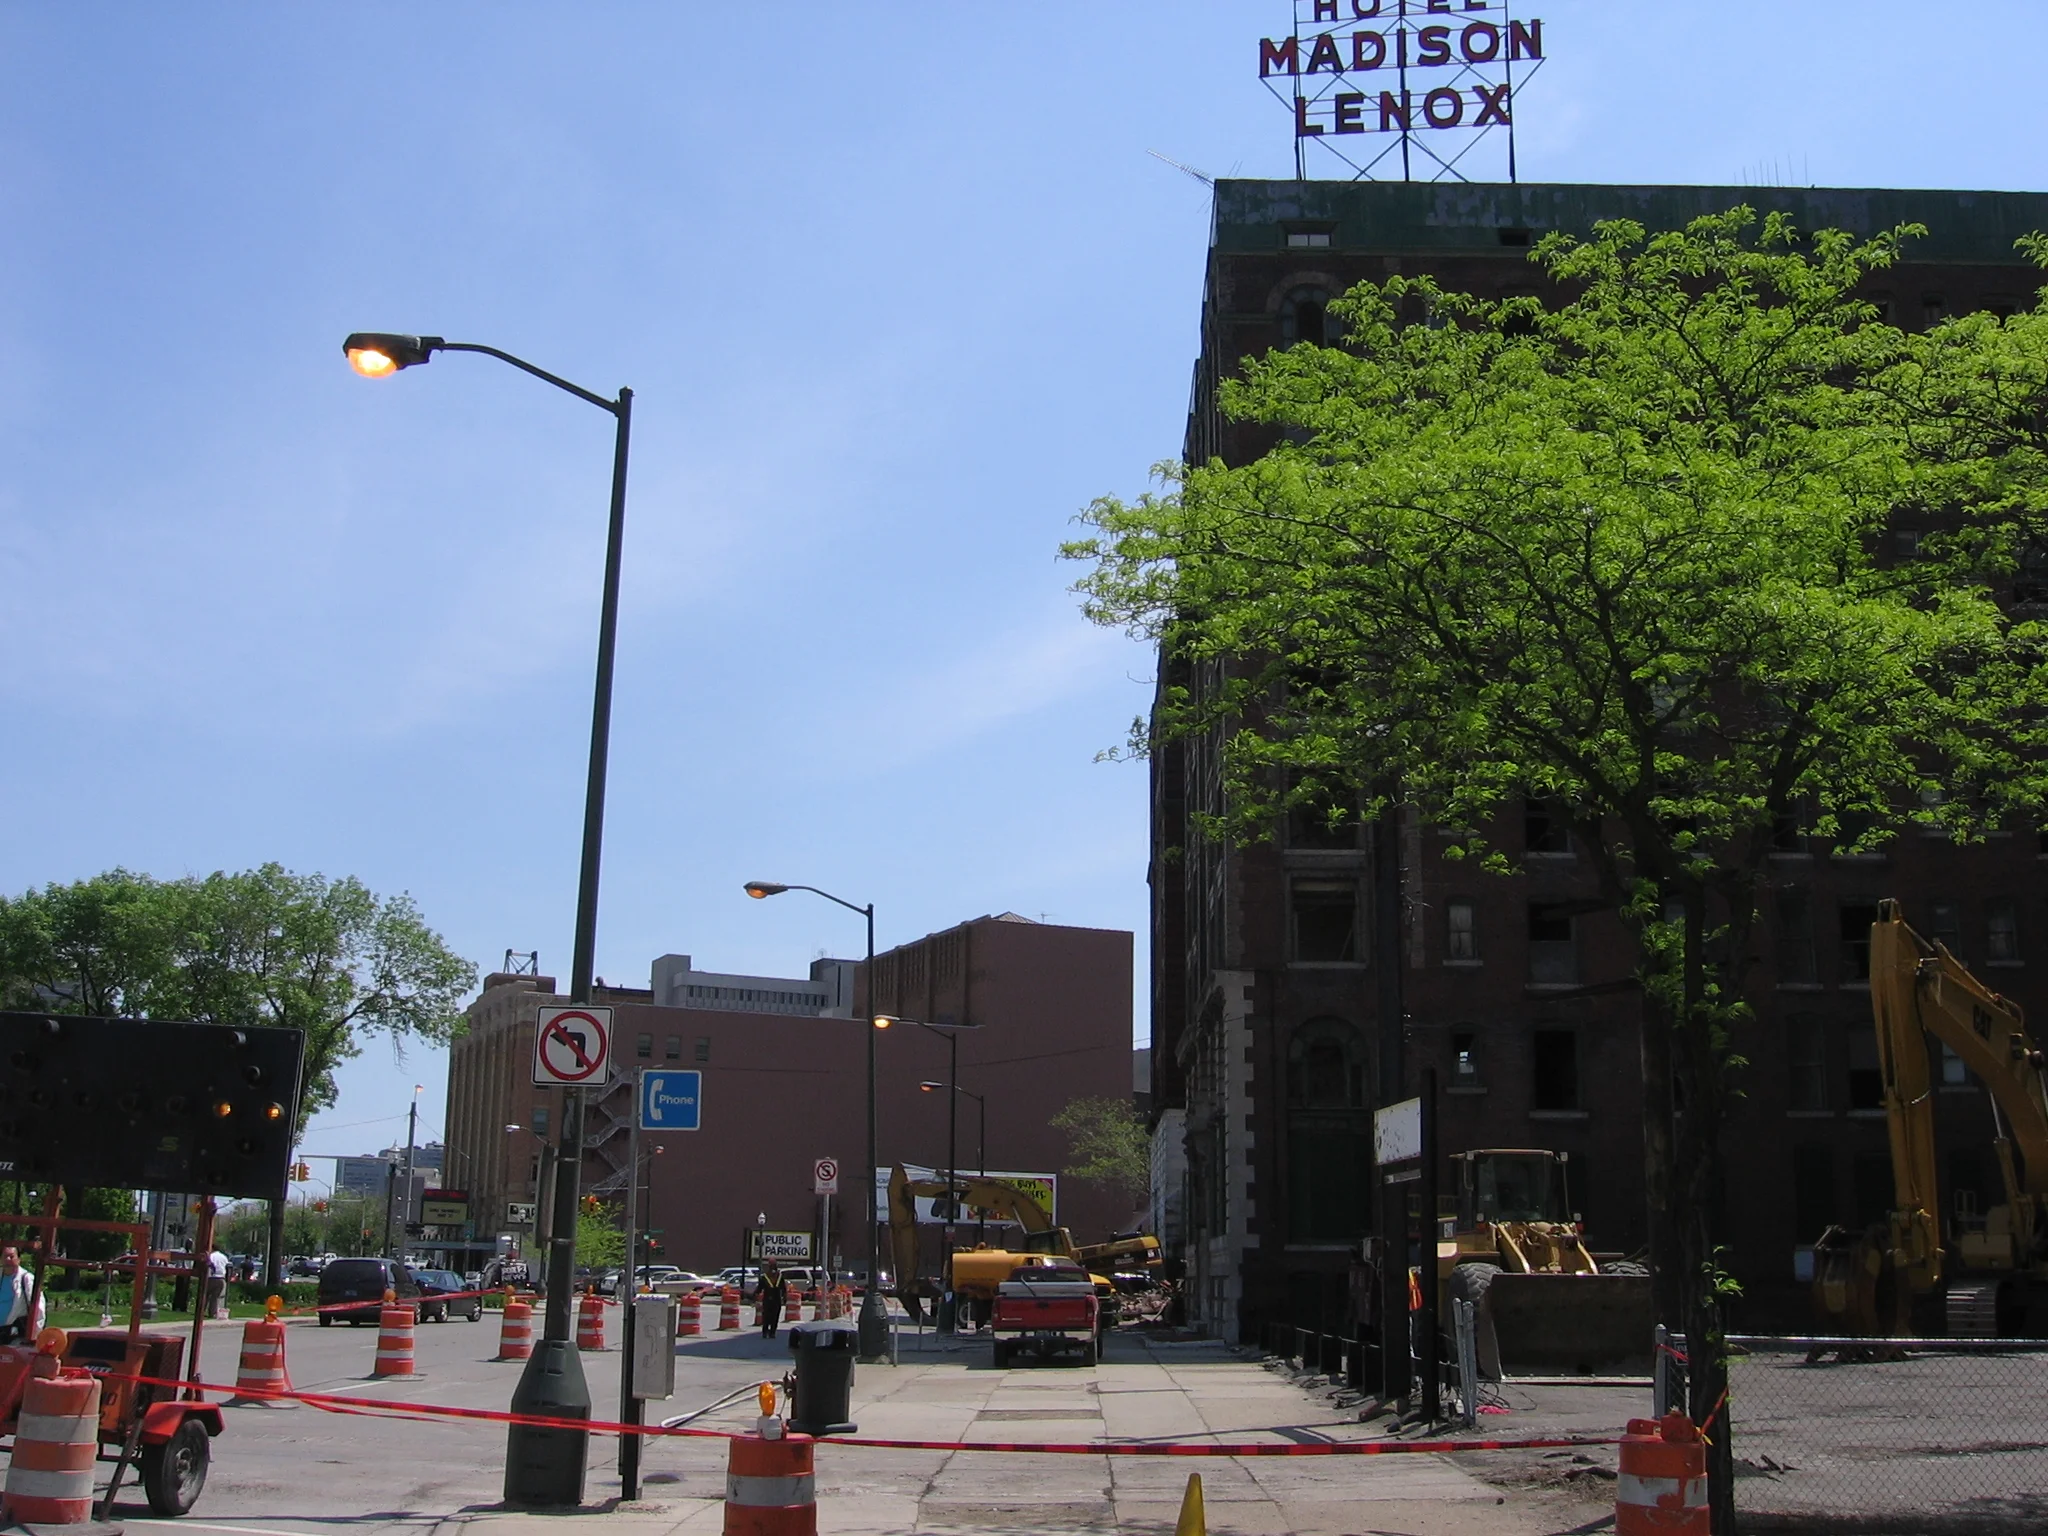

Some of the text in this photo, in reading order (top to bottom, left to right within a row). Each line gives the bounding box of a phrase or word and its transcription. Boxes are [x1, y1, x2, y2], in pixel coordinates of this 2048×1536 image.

[1313, 0, 1487, 23] HOT
[1259, 19, 1542, 78] MADISON
[1294, 83, 1512, 137] LENOX
[659, 1094, 694, 1104] Phone
[765, 1235, 802, 1245] PUBLIC
[765, 1246, 808, 1256] PARKING
